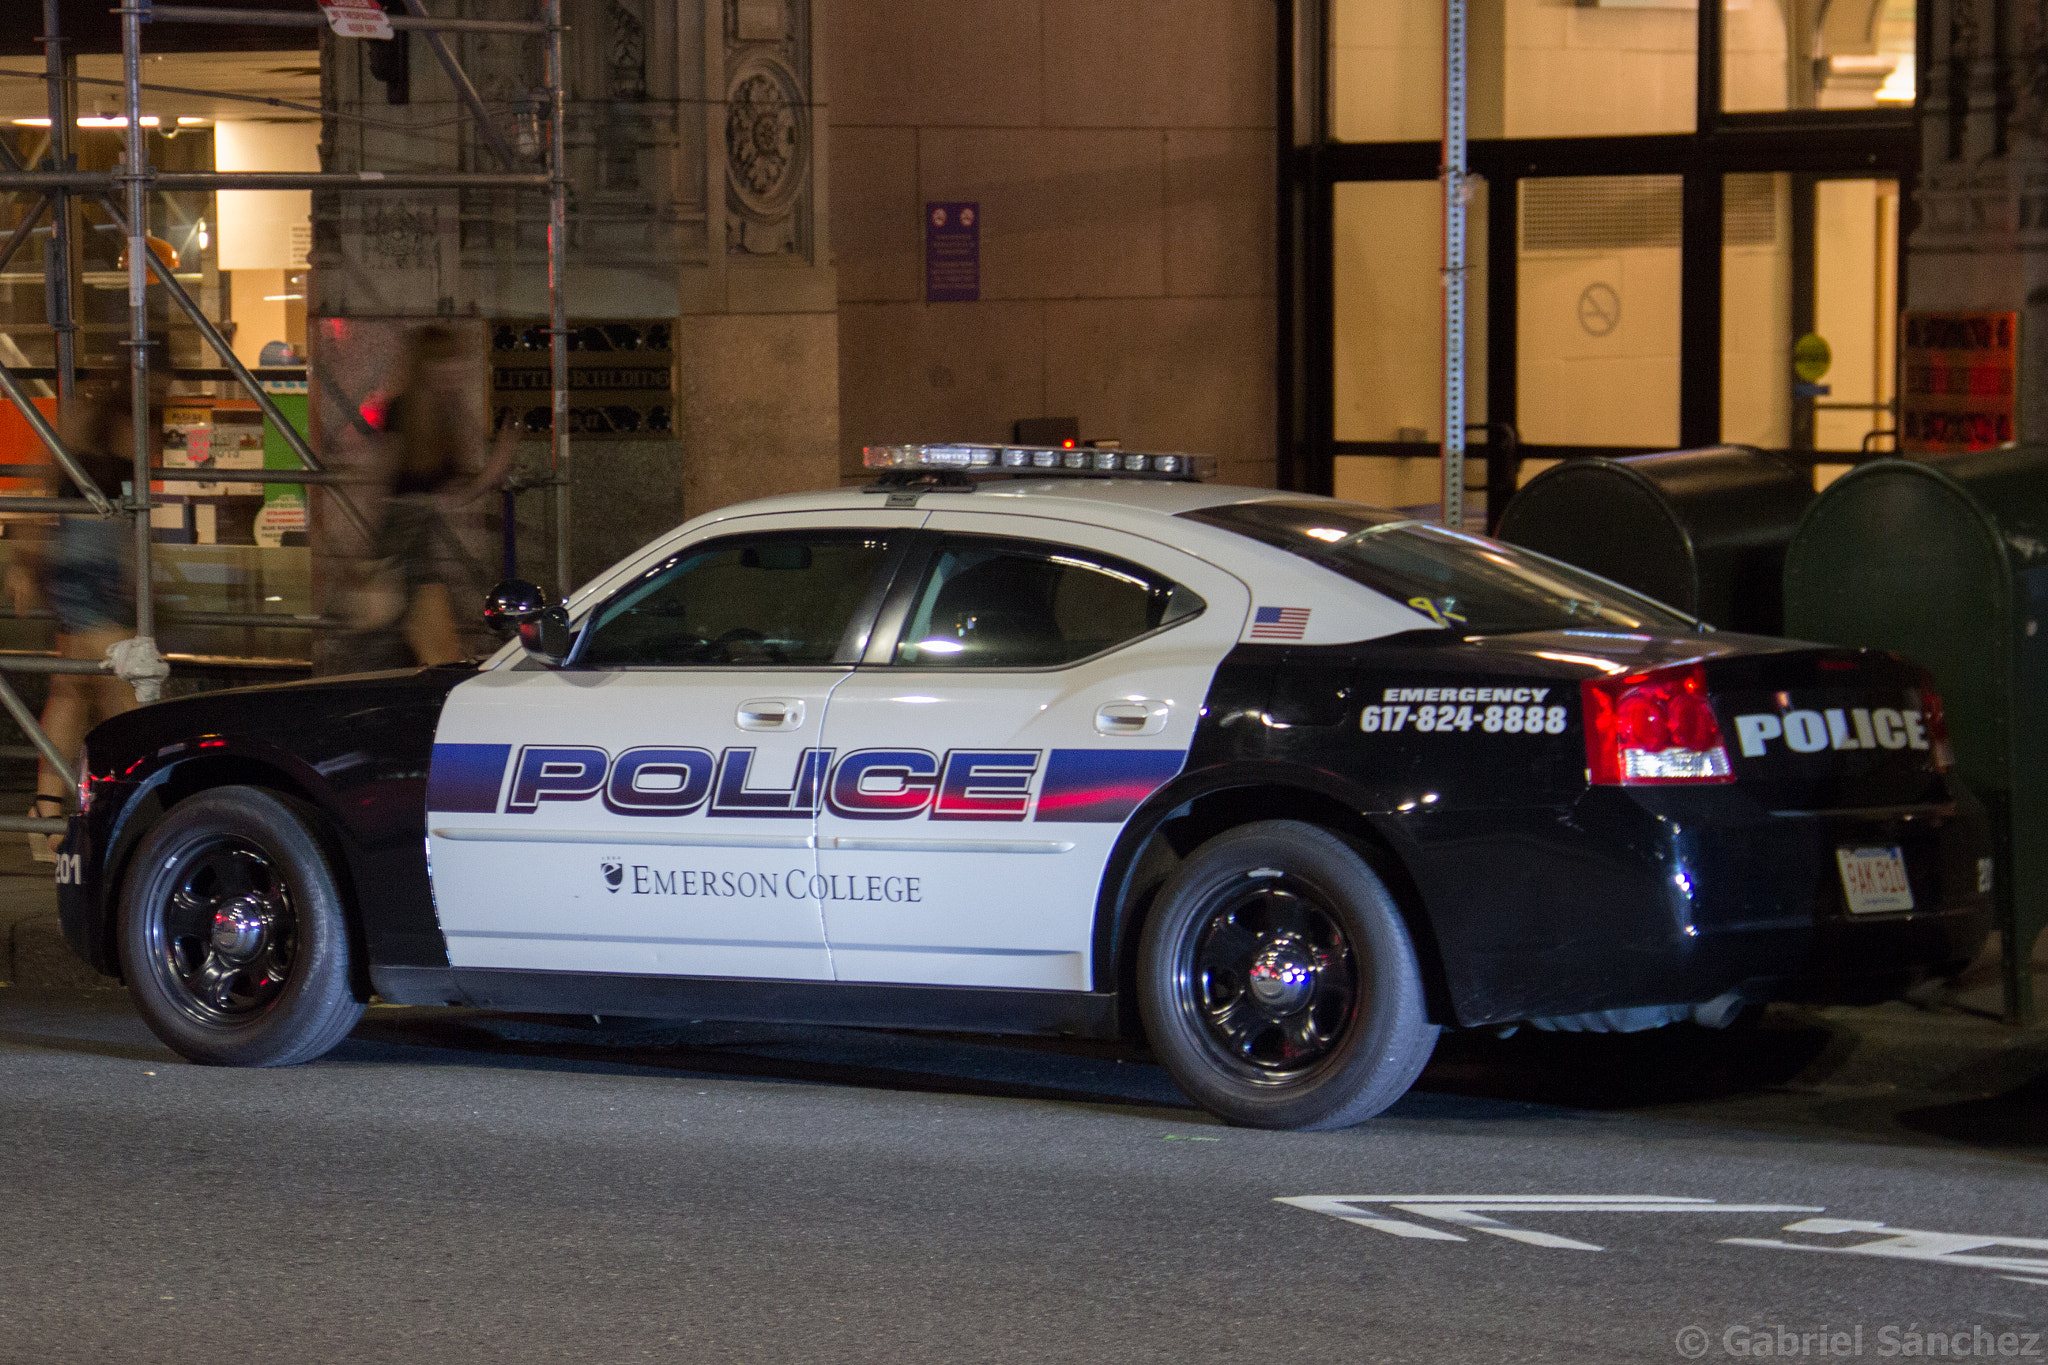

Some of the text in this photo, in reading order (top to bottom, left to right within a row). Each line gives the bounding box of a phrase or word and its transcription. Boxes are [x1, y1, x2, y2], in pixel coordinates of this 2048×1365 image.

[494, 369, 556, 388] LITTL
[1382, 688, 1550, 703] EMERGENCY
[1360, 704, 1568, 734] 617-824-8888
[1734, 708, 1930, 757] POLICE
[504, 743, 1044, 822] POLICE
[55, 853, 82, 885] 201
